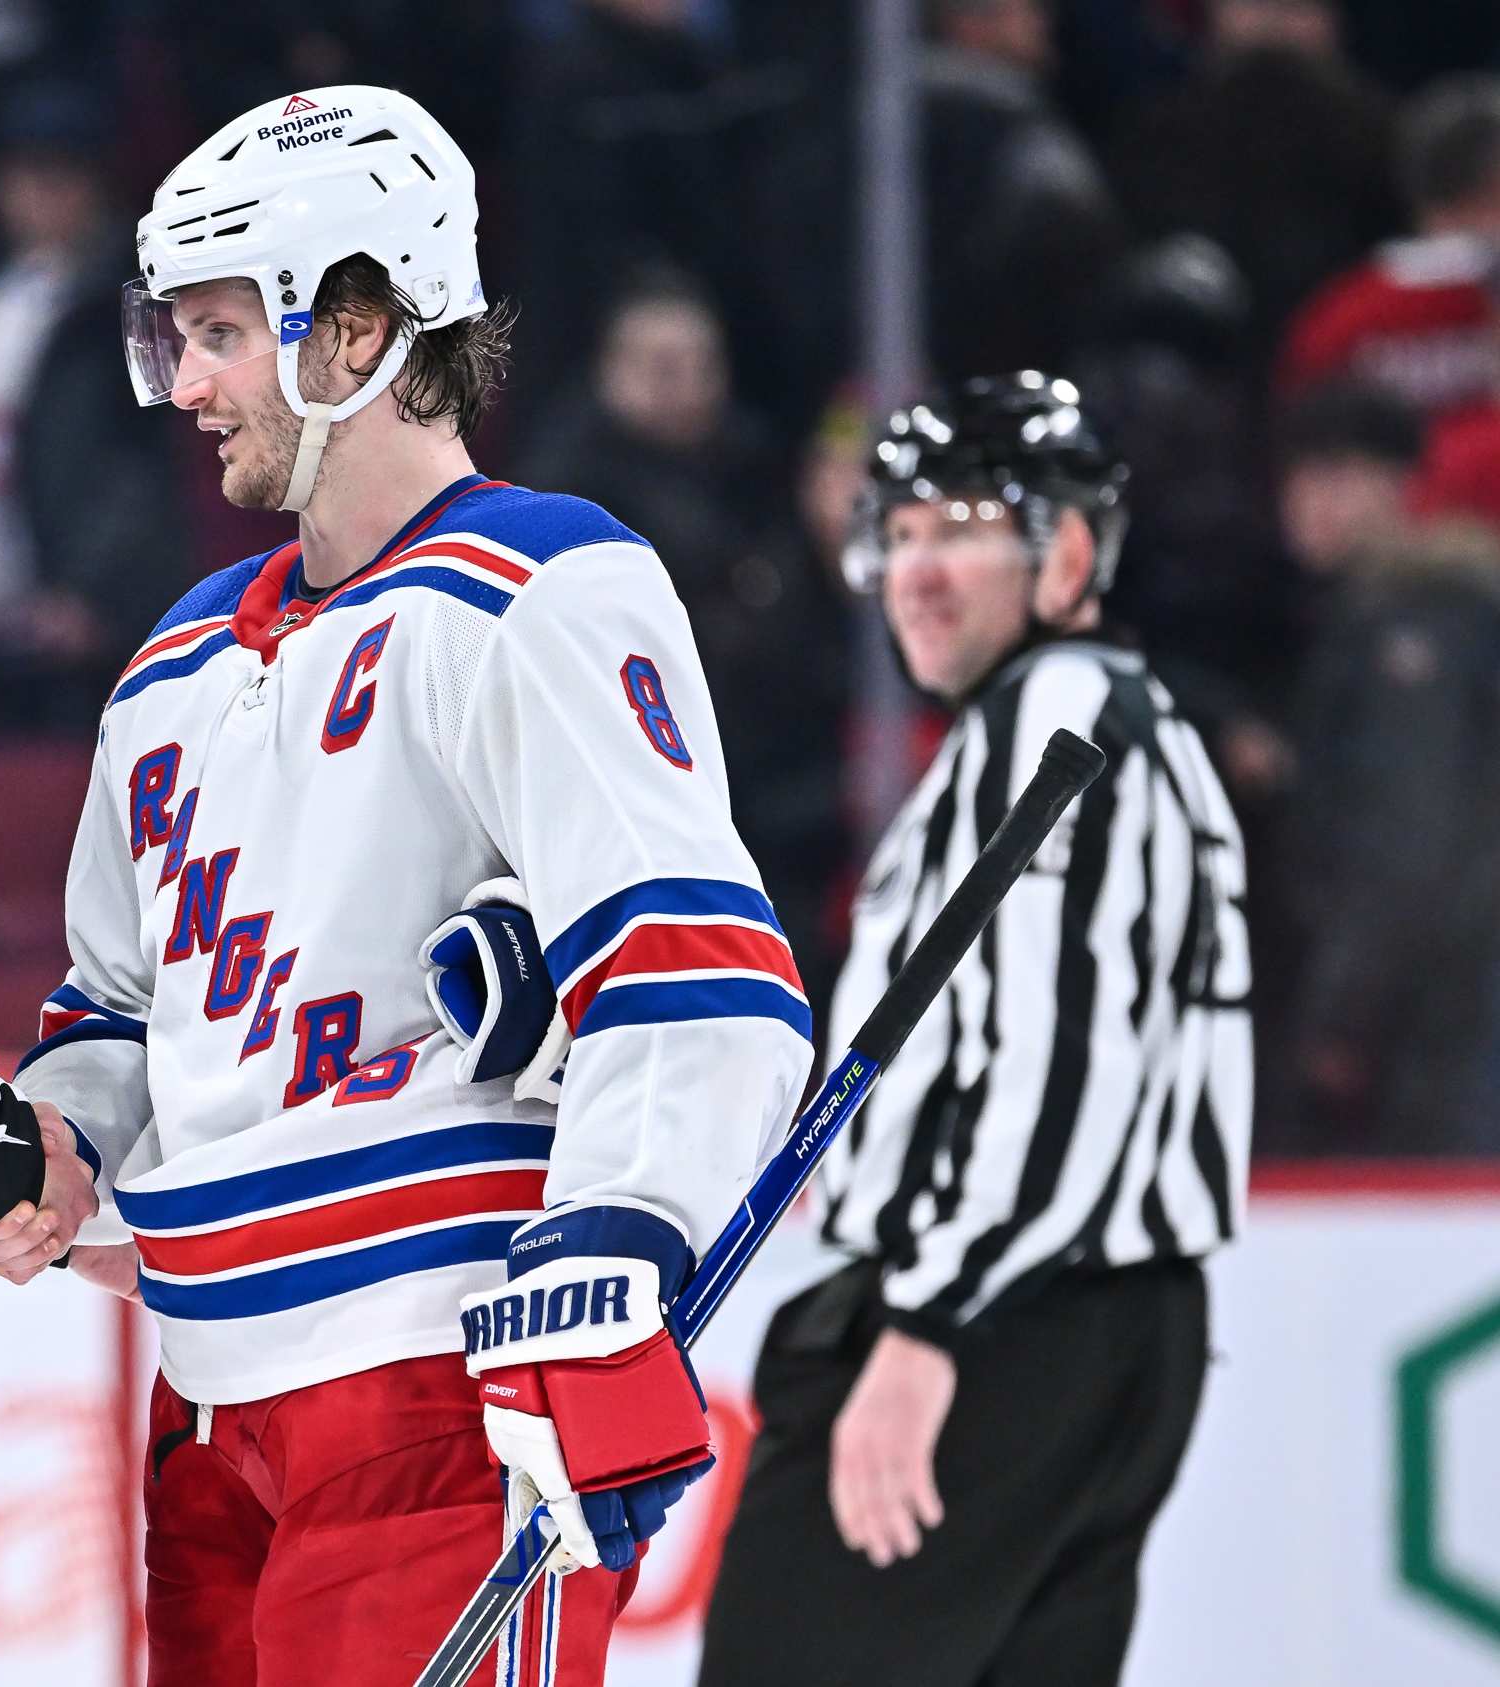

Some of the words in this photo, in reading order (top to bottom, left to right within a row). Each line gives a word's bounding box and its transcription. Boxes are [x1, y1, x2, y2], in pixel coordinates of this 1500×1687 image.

[257, 107, 353, 140] Benjamin
[276, 125, 344, 152] Moore
[321, 612, 396, 755] C
[619, 653, 693, 772] 8
[796, 1061, 864, 1159] HYPERLITE
[484, 1383, 519, 1399] COVERT
